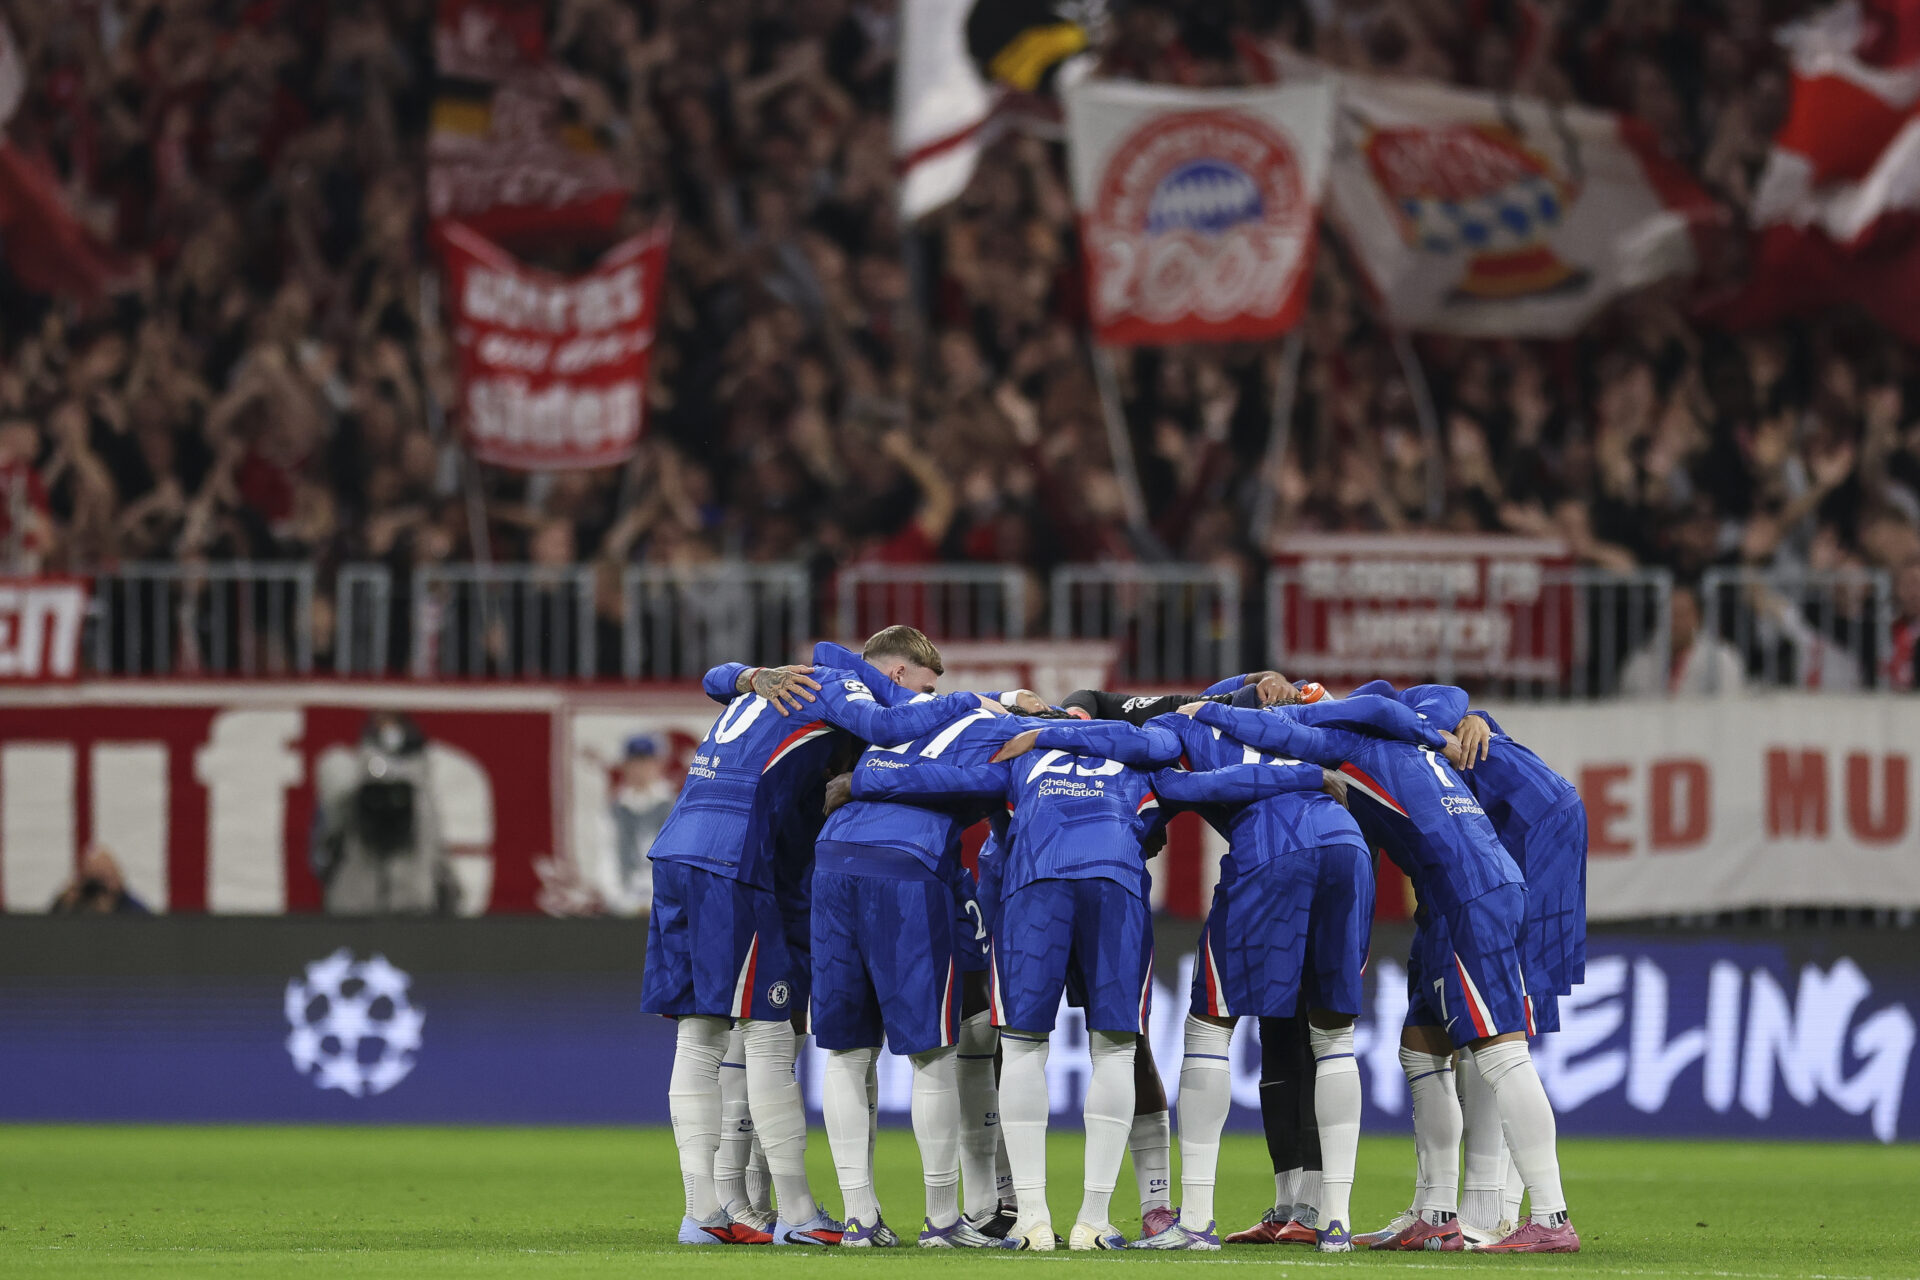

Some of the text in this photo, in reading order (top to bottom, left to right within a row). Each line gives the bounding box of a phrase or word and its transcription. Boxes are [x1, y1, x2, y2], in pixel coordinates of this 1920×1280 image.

[702, 691, 767, 744] 0
[692, 753, 710, 766] helsea
[1039, 778, 1086, 789] Chelsea
[1038, 786, 1104, 798] Foundation
[1433, 976, 1448, 1021] 7
[1532, 955, 1917, 1145] ELING
[1149, 1179, 1168, 1187] CFC
